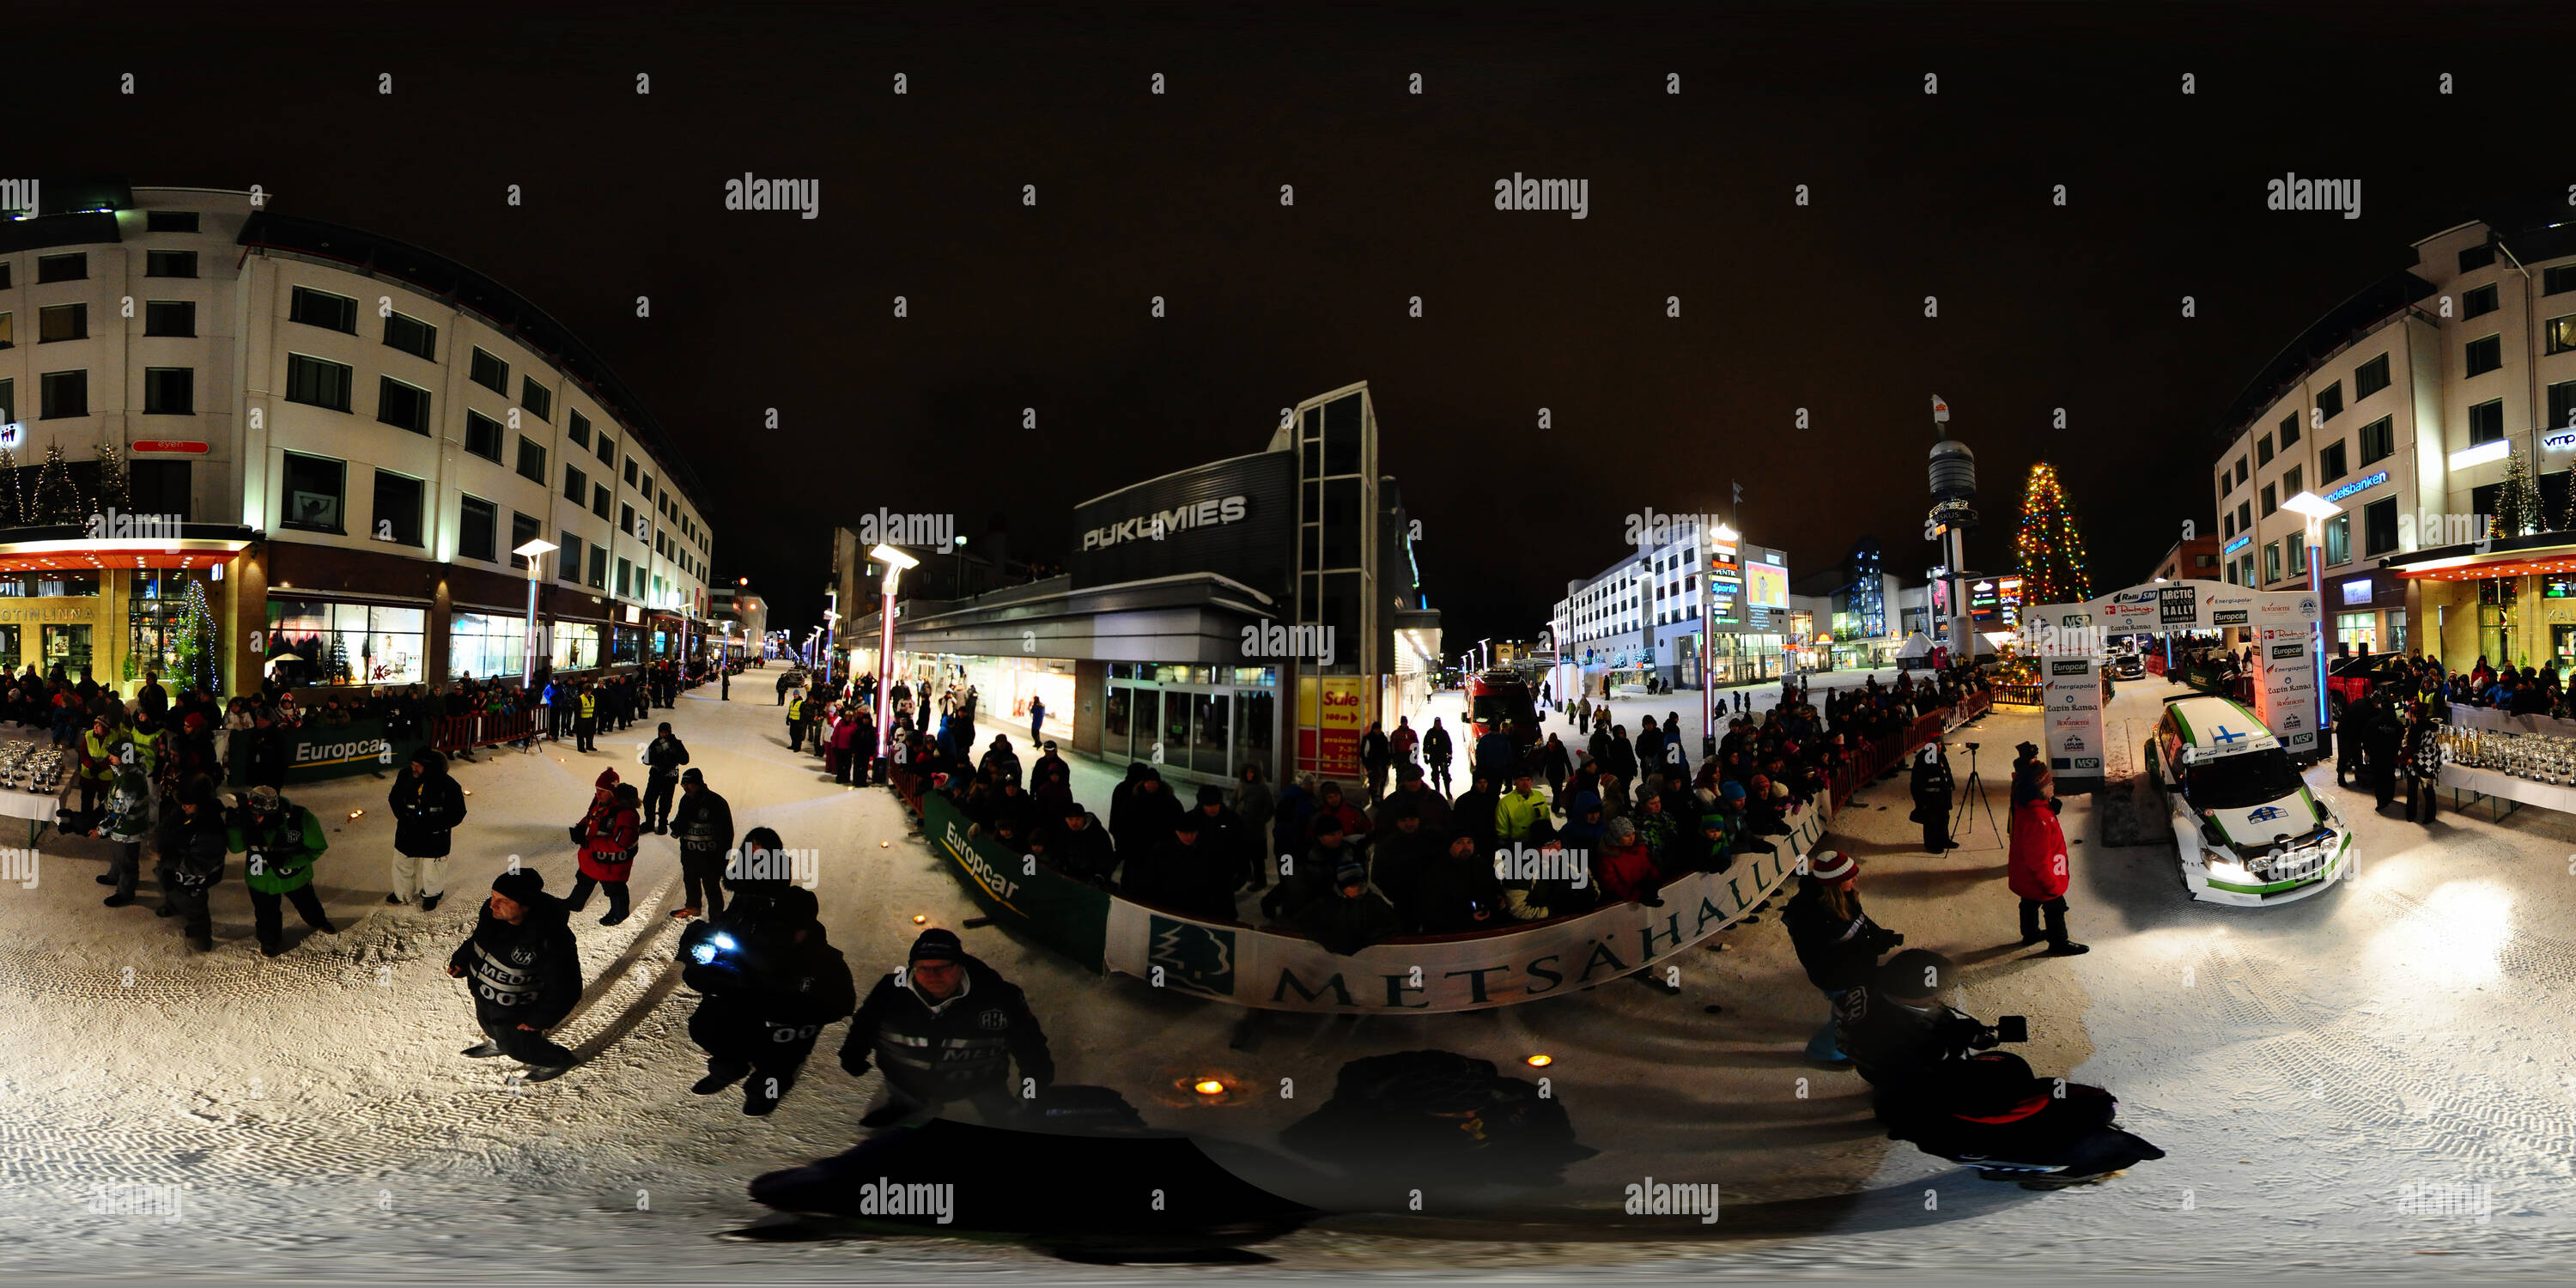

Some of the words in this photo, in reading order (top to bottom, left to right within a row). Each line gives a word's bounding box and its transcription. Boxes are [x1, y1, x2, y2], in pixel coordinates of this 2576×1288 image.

[2544, 434, 2576, 447] vmp
[1083, 495, 1246, 551] PUKUMIES
[2162, 589, 2193, 599] ARCTIC
[1, 607, 94, 621] OTINLINNA
[2163, 605, 2194, 616] RALLY
[2066, 616, 2090, 628] MSP
[2215, 613, 2247, 623] Europcar
[2274, 647, 2302, 656] Europcar
[2053, 663, 2087, 673] Europcar
[1323, 690, 1359, 706] Sale
[2294, 734, 2312, 744] MSP
[2077, 759, 2097, 769] MSP
[946, 820, 1019, 900] Europcar
[1271, 805, 1827, 1009] METSÄHALLITUS
[481, 963, 537, 985] MEDI
[479, 984, 538, 1006] 003
[773, 1024, 817, 1043] 00
